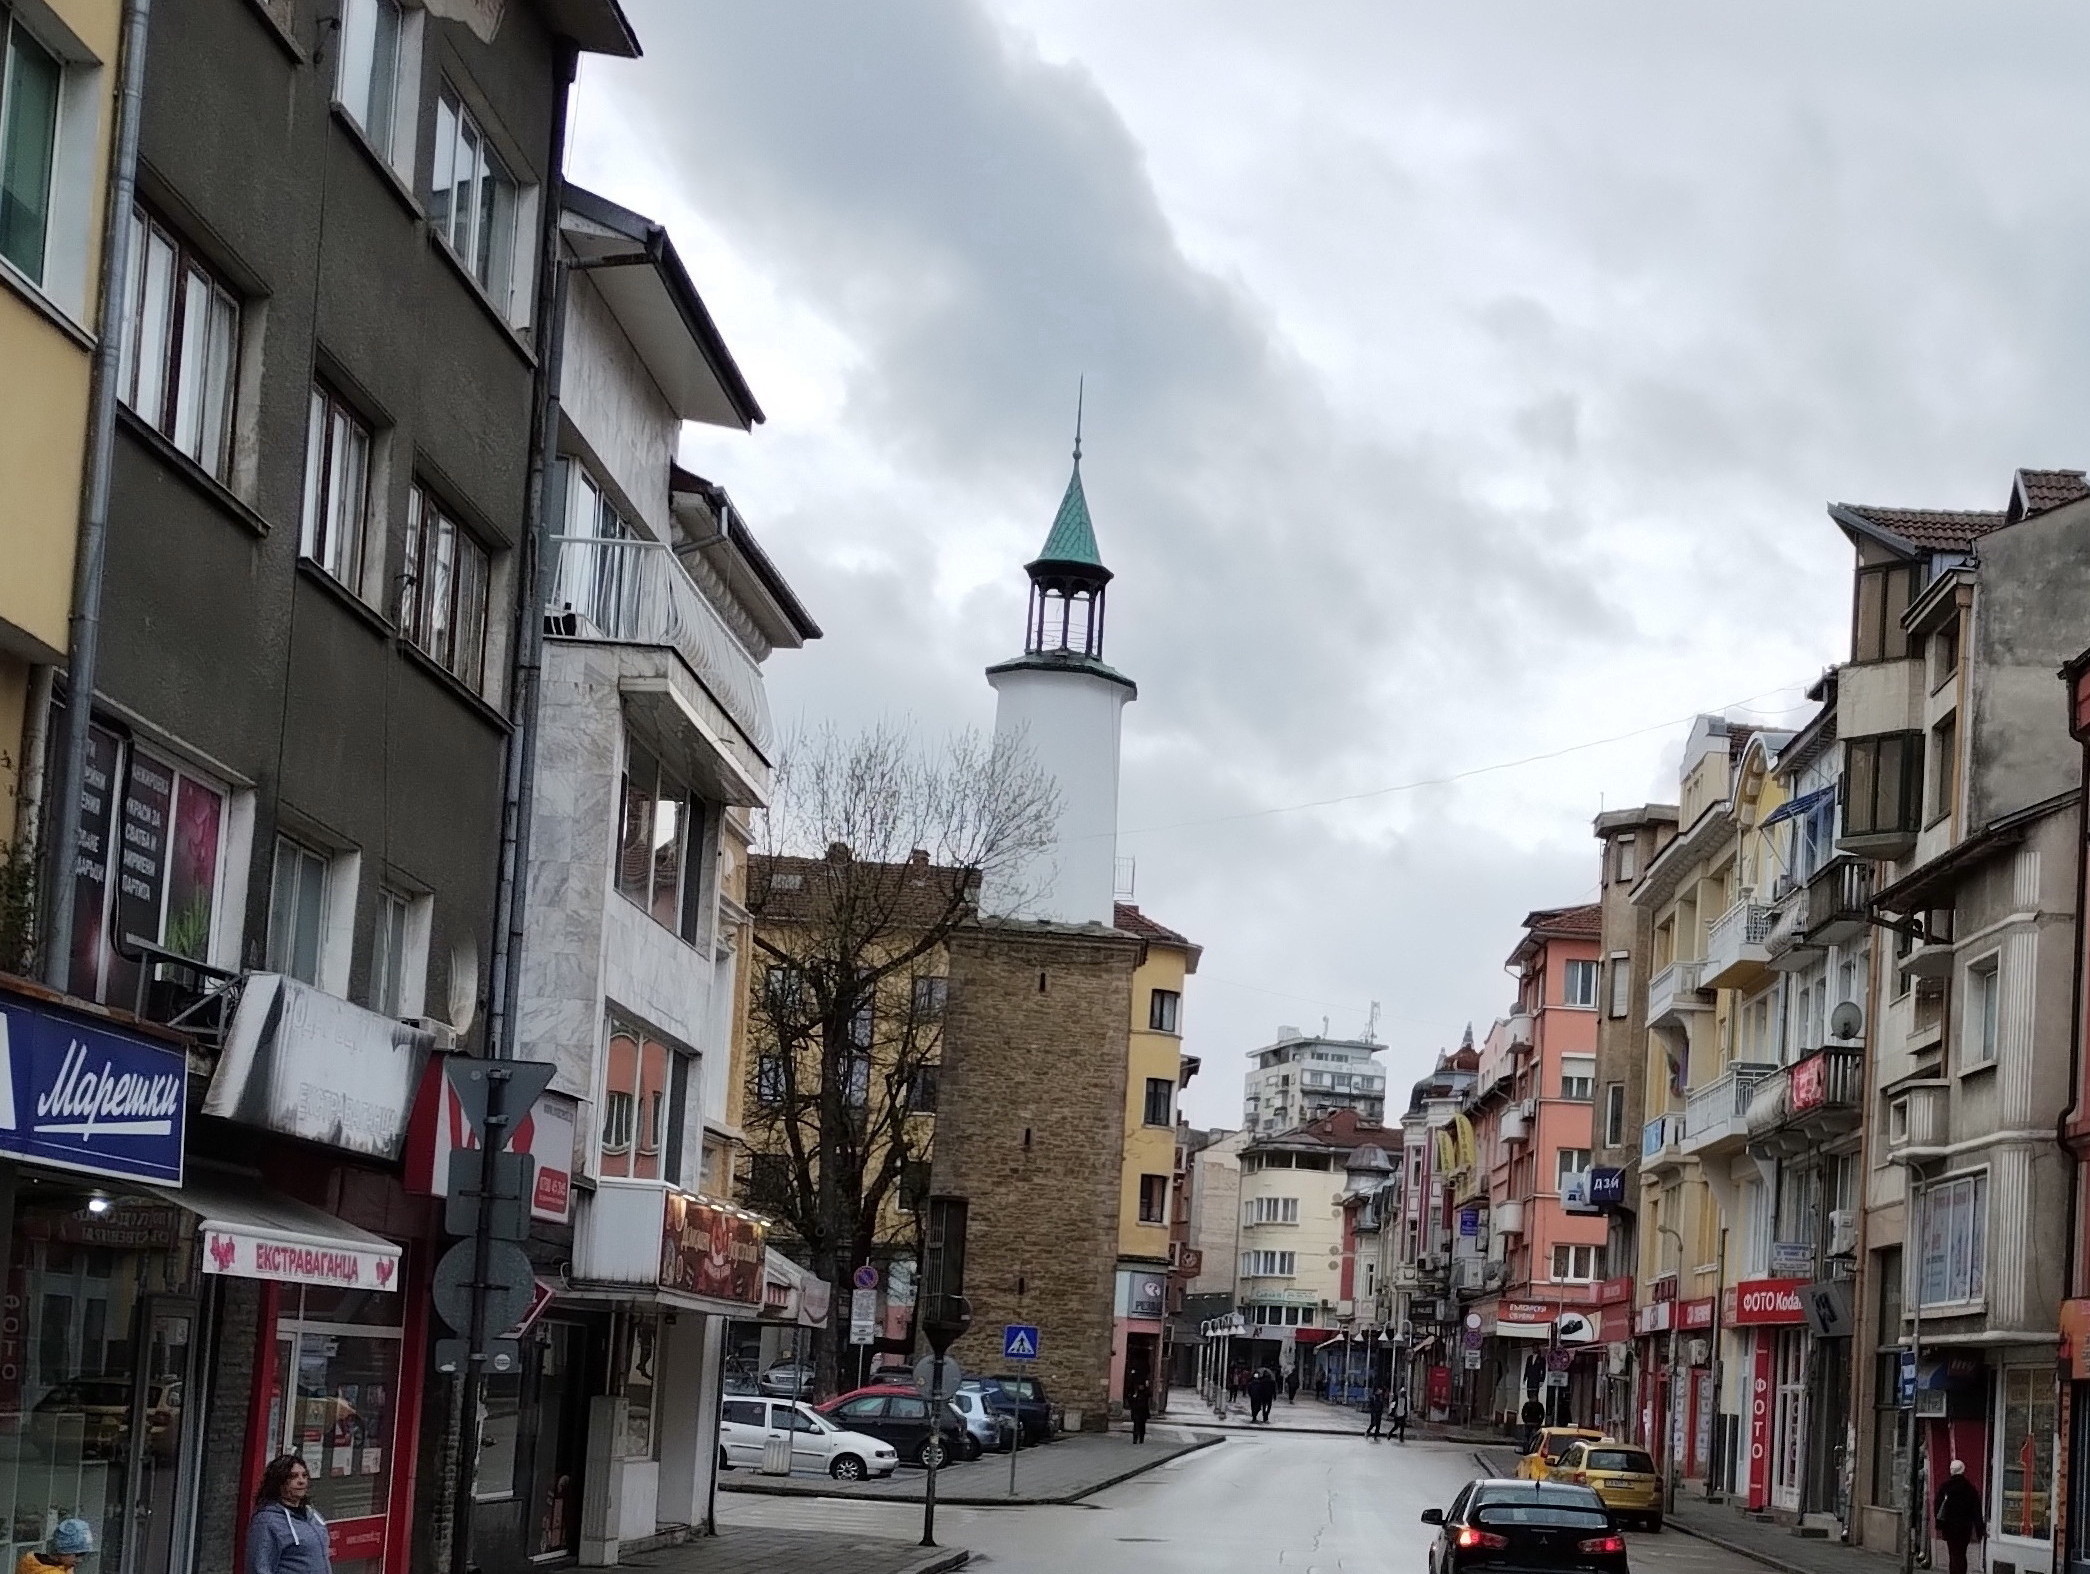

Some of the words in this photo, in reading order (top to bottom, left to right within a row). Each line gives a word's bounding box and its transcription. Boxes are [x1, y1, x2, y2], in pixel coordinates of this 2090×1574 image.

[37, 1038, 180, 1142] Марешки
[256, 1243, 359, 1284] ЕКСТРАВАГАНЦА
[1743, 1291, 1774, 1311] ФОТО
[1776, 1290, 1804, 1311] Koda
[1752, 1377, 1767, 1459] ФОТО
